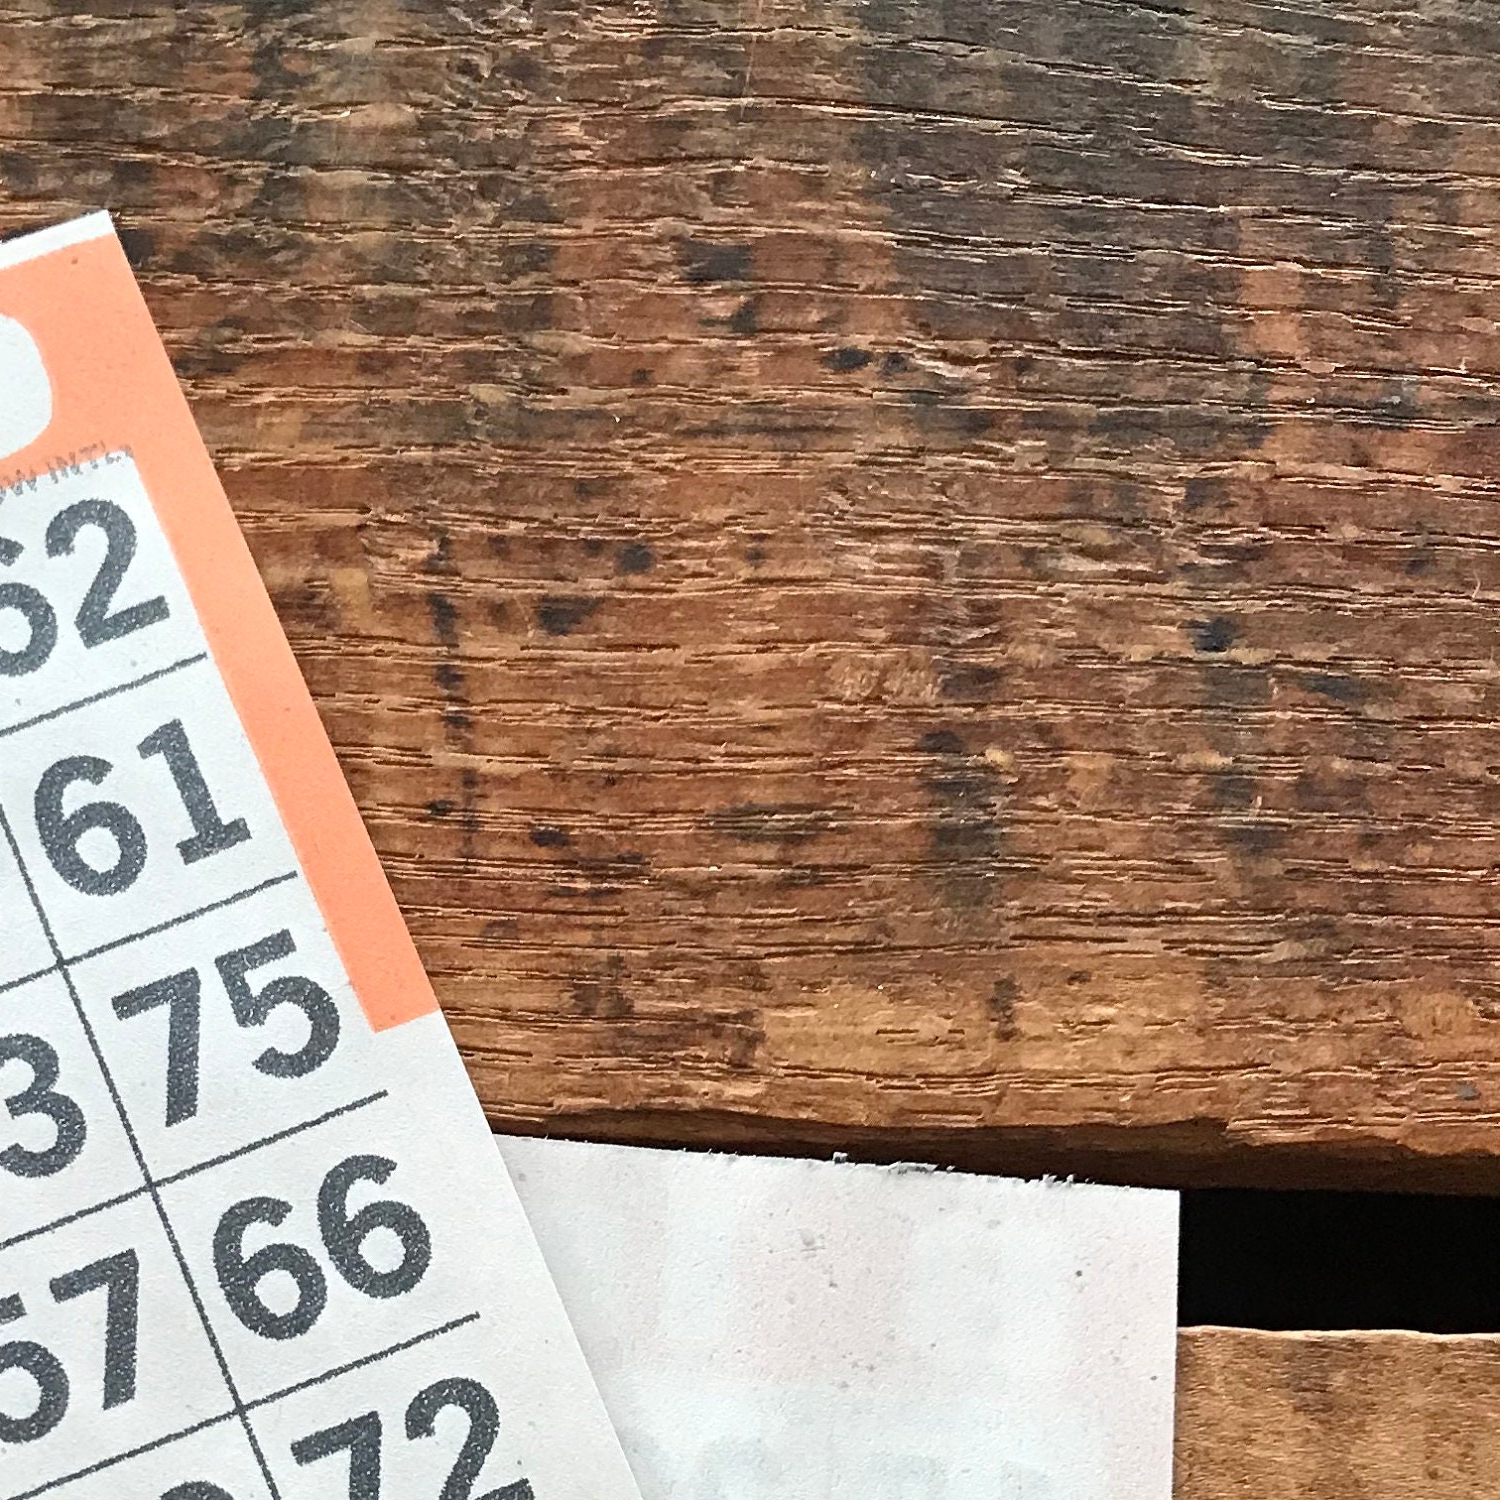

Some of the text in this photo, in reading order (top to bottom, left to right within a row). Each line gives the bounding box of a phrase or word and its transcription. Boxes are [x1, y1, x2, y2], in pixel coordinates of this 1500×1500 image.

[33, 718, 253, 897] 61
[110, 928, 342, 1128] 75
[212, 1154, 433, 1342] 66
